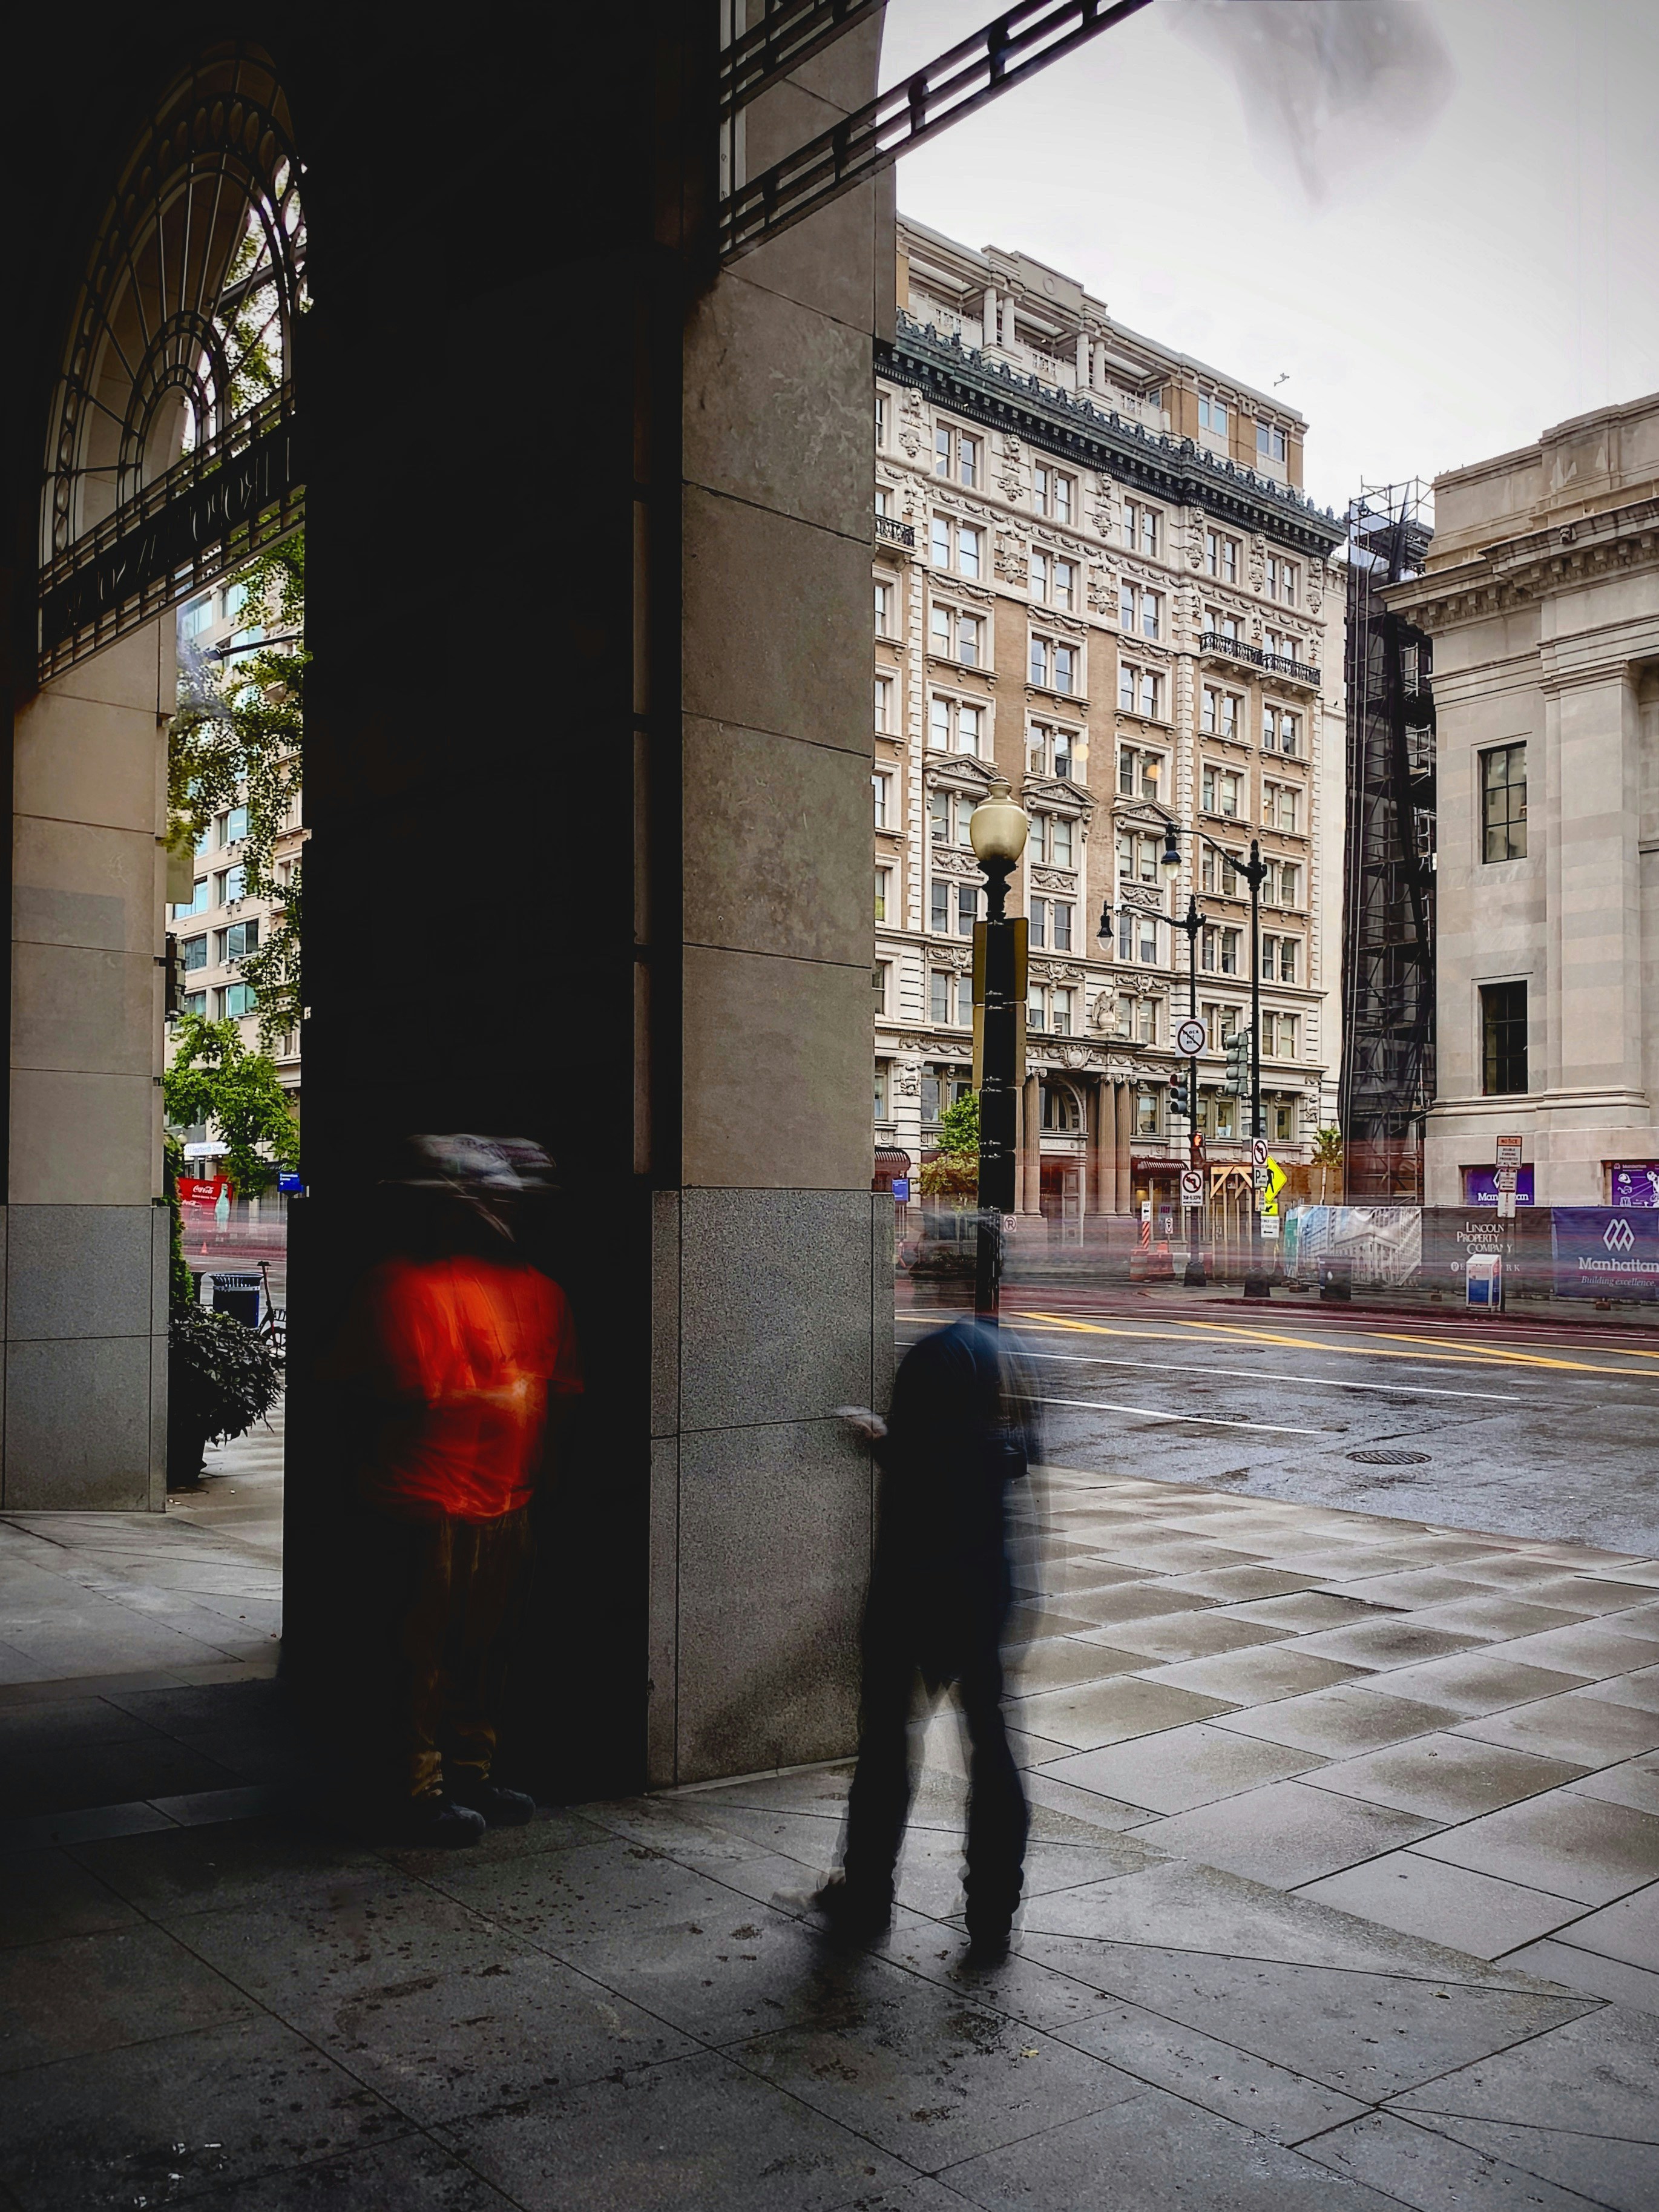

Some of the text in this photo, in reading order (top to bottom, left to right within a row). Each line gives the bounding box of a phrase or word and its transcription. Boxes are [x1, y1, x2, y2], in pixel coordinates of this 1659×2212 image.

[1477, 1193, 1529, 1202] Manan
[1465, 1222, 1505, 1233] LINCOLN
[1456, 1231, 1499, 1243] PROPERTY
[1578, 1257, 1659, 1273] Manhattan
[1581, 1276, 1657, 1287] Building excellence.
